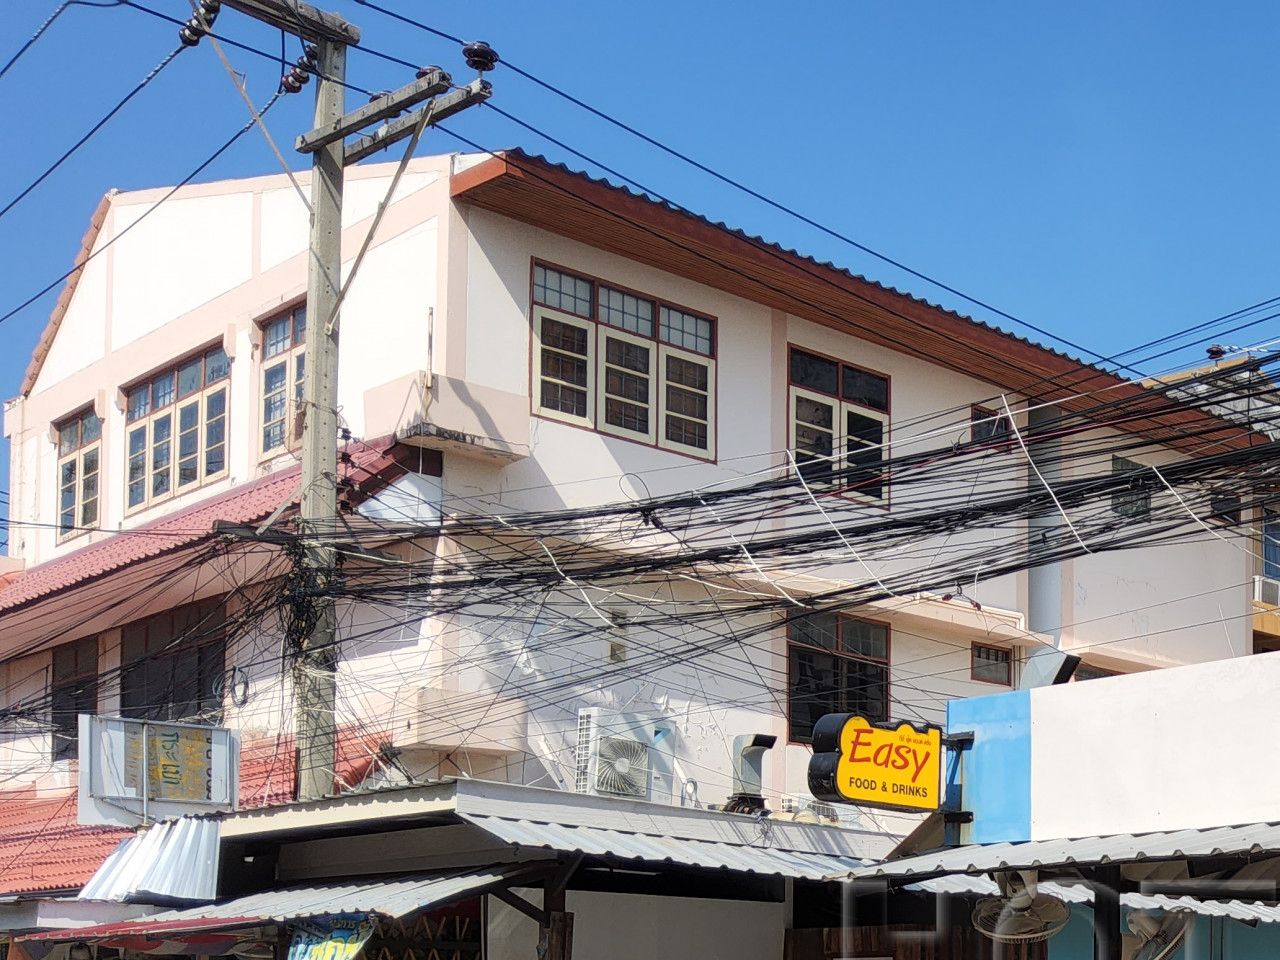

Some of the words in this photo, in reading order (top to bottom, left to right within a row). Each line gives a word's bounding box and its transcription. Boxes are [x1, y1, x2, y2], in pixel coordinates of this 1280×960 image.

[849, 729, 930, 783] Easy
[849, 776, 877, 790] FOOD
[881, 781, 888, 792] &
[892, 784, 928, 798] DRINKS
